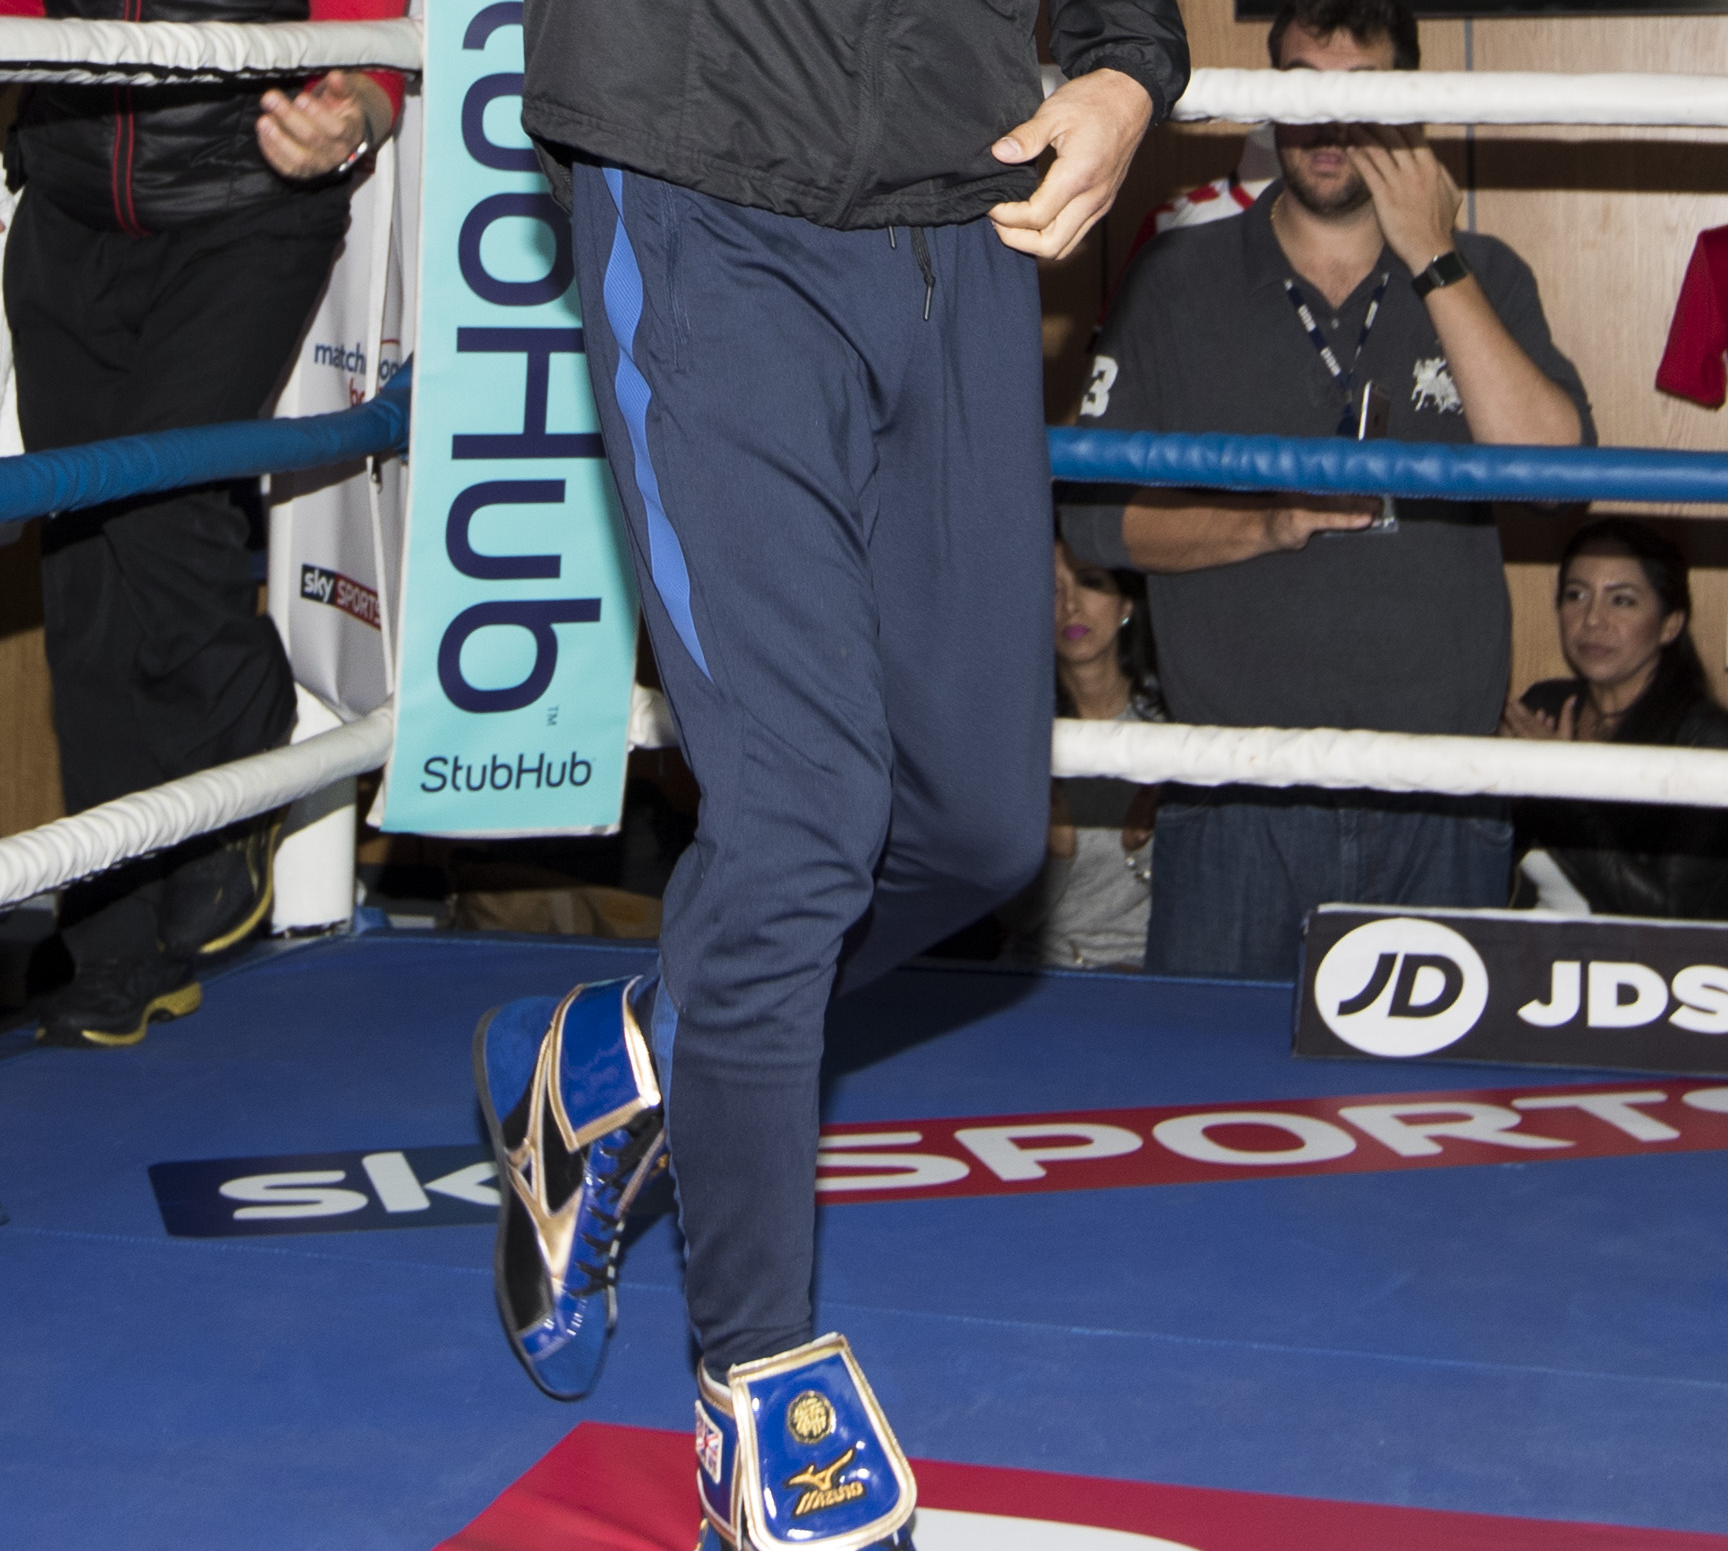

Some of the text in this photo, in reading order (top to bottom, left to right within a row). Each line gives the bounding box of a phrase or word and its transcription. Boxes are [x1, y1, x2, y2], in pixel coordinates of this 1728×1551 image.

[304, 568, 334, 604] sky
[420, 751, 592, 793] StubHub
[1337, 951, 1465, 1019] JD
[218, 1151, 502, 1220] sk
